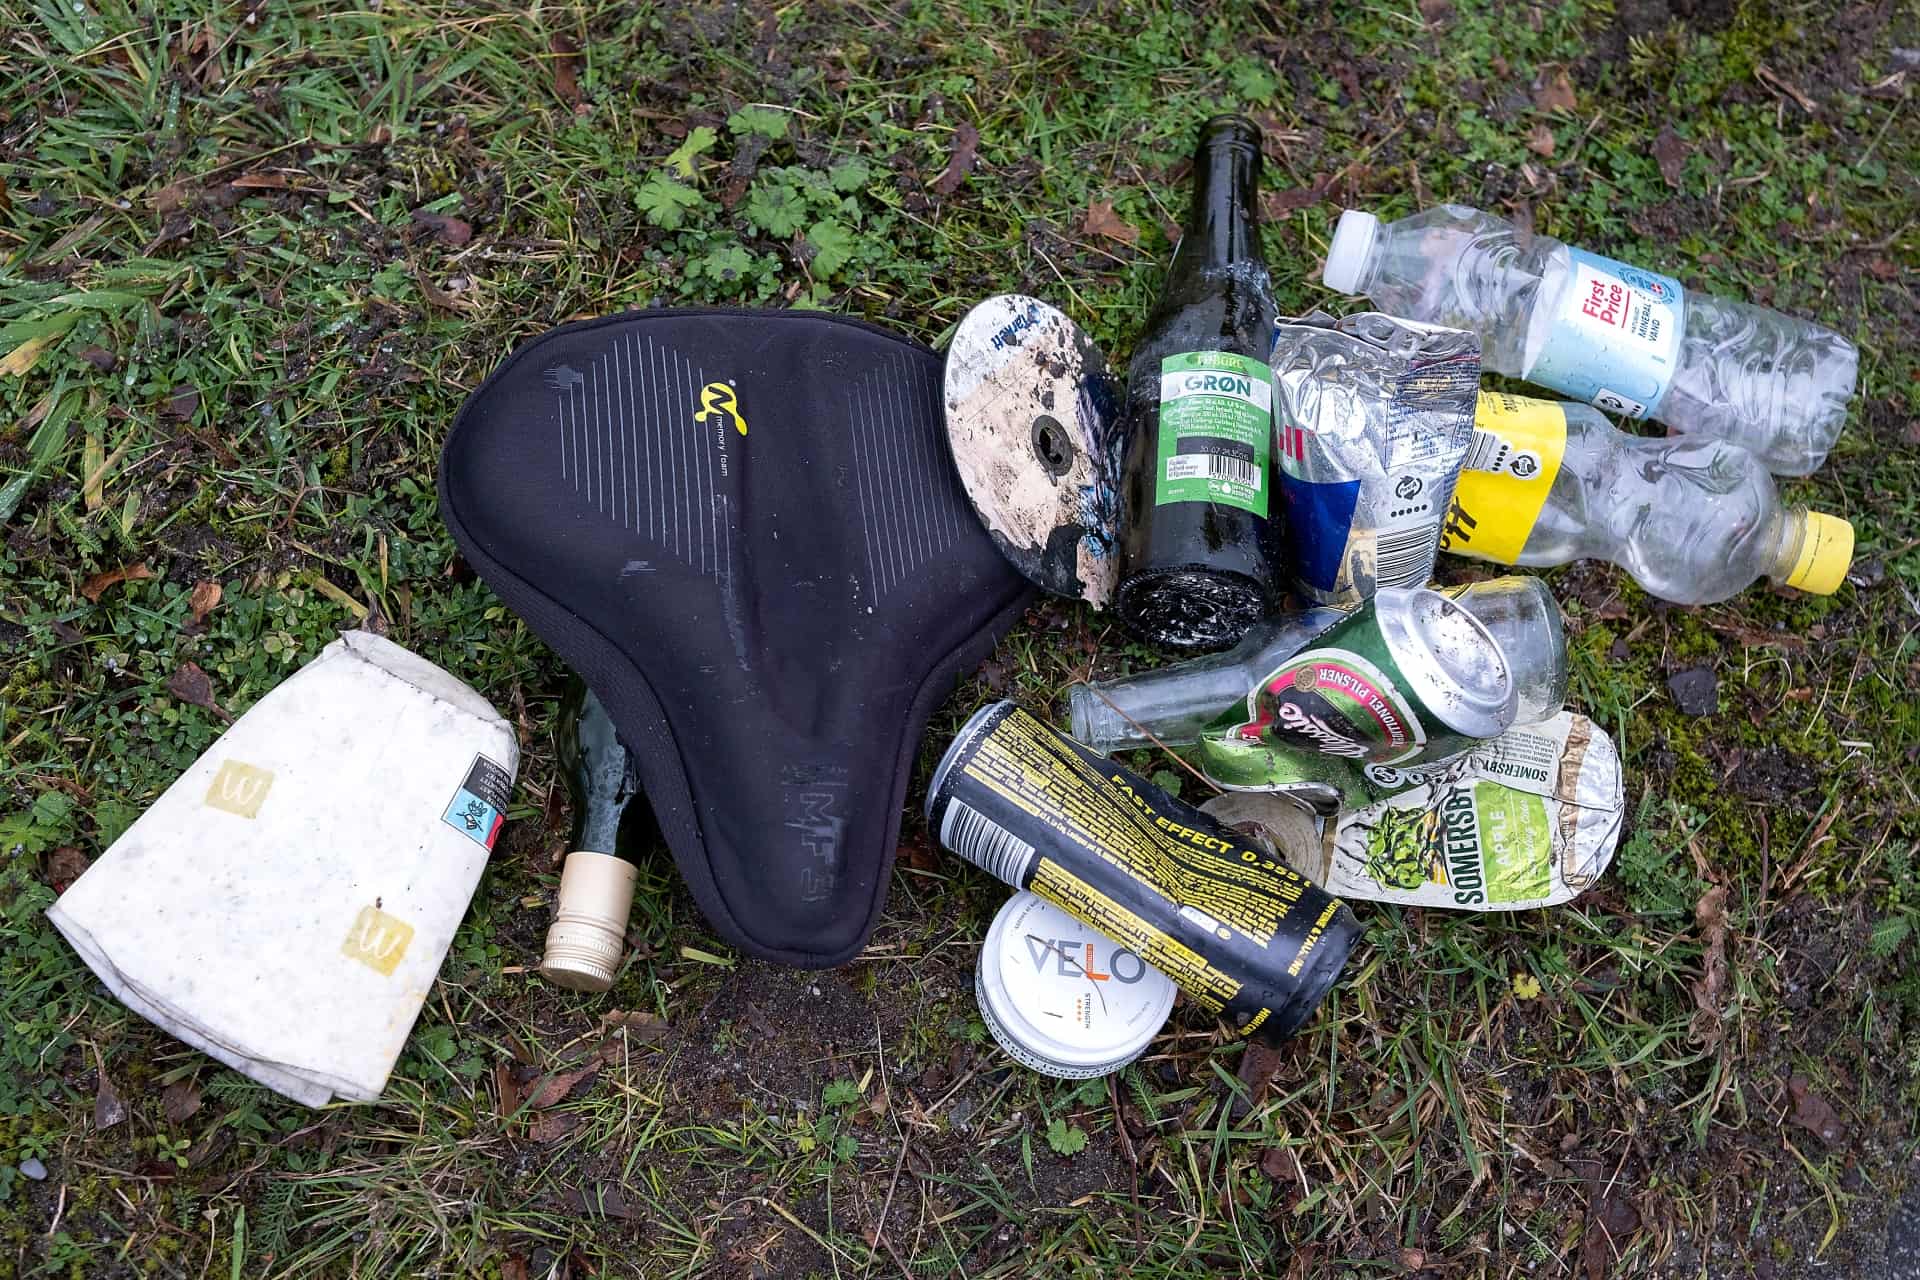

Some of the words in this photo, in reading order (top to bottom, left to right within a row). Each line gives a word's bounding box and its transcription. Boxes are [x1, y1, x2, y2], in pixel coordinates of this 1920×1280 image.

[1582, 280, 1606, 318] First
[1600, 284, 1623, 326] Price
[1637, 303, 1652, 339] MINERAL
[1648, 319, 1661, 342] VAND
[1185, 374, 1251, 398] GRØN
[716, 416, 725, 450] memory
[720, 454, 729, 477] foam
[1318, 668, 1369, 700] PILSNER
[1483, 759, 1548, 783] SOMERSBY
[1111, 774, 1156, 820] FAST
[1155, 815, 1235, 855] EFFECT
[1241, 849, 1302, 884] 0,355
[1446, 786, 1485, 905] SOMERSBY
[1489, 810, 1507, 865] APPLE
[1023, 938, 1146, 985] VELO
